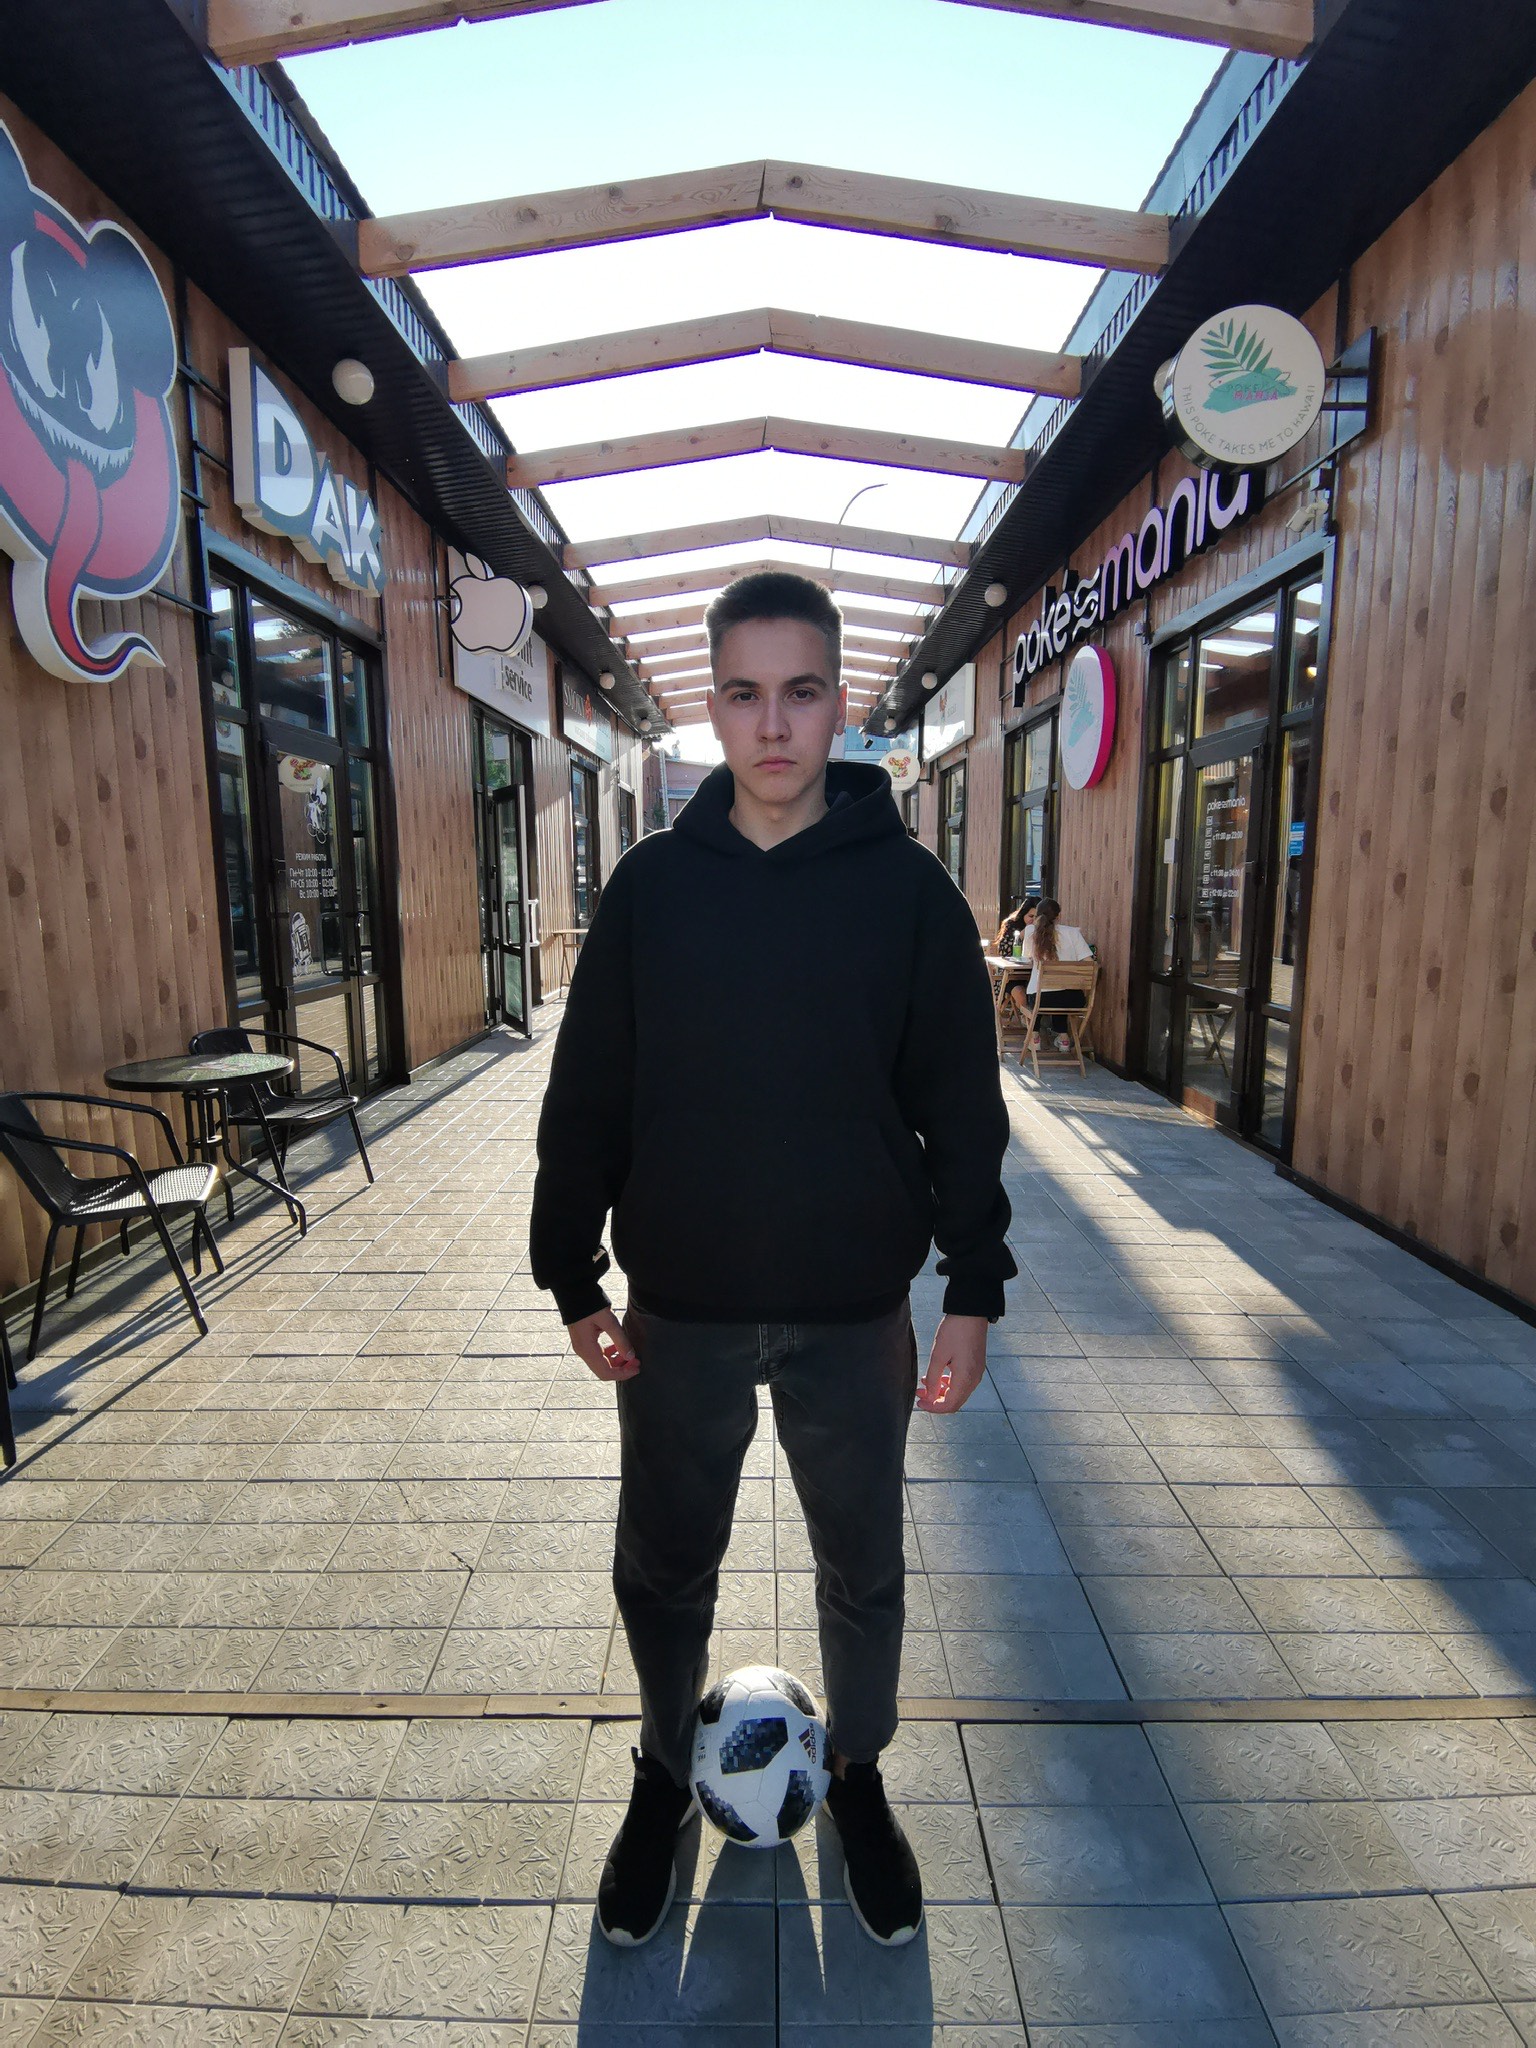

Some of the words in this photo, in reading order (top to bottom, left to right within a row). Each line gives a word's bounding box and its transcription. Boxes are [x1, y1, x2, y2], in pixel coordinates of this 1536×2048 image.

[1183, 384, 1195, 415] THIS
[1191, 417, 1217, 444] POKE
[1219, 438, 1256, 455] TAKES
[1259, 438, 1276, 451] ME
[1276, 427, 1294, 442] TO
[1293, 384, 1316, 428] HAWAII
[252, 358, 384, 582] DAK
[504, 664, 533, 703] service
[809, 1722, 817, 1765] adidas
